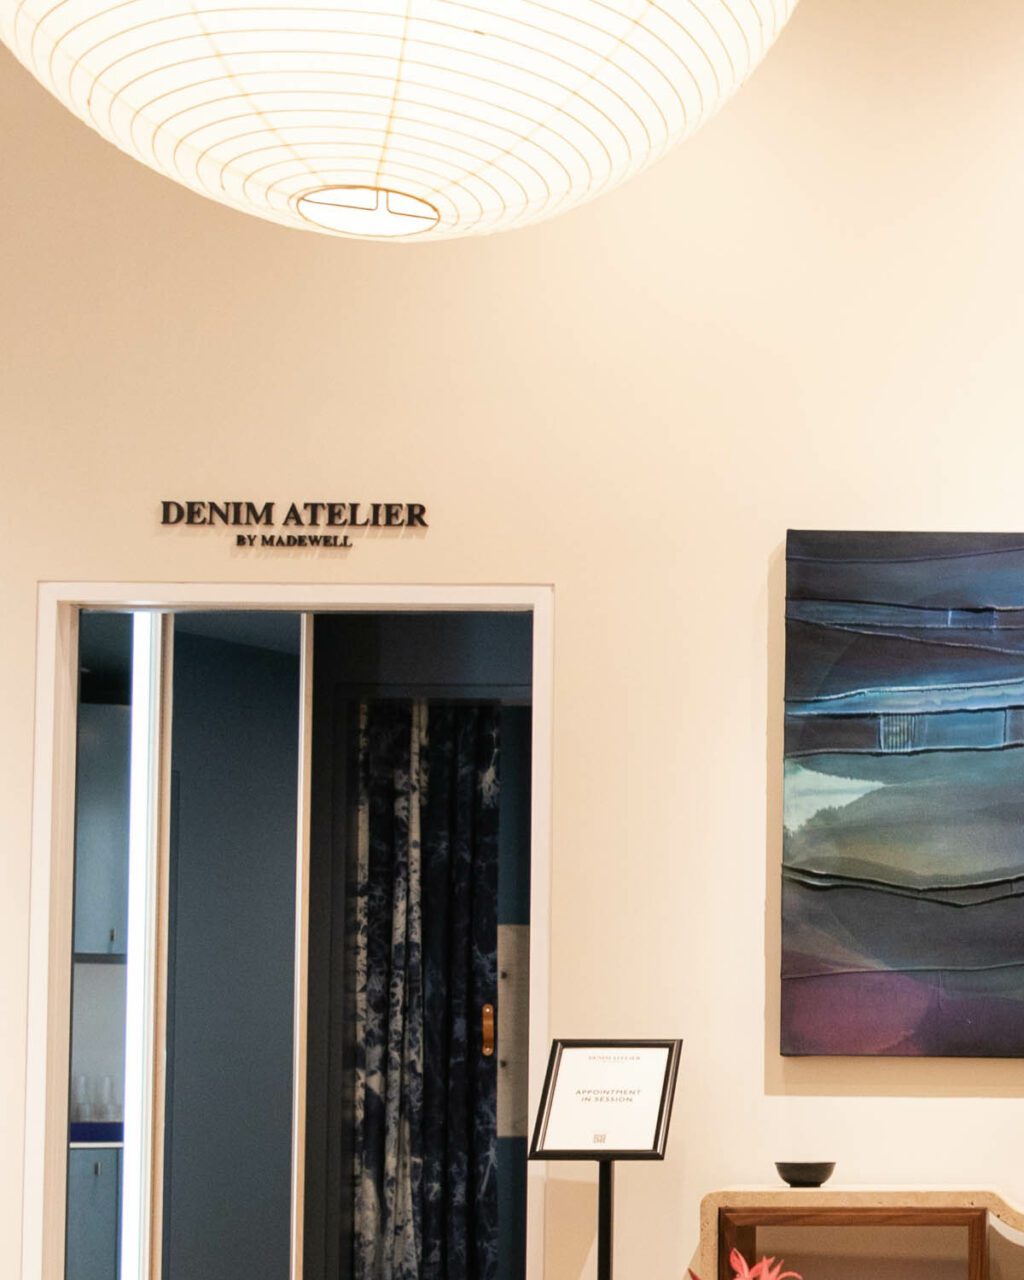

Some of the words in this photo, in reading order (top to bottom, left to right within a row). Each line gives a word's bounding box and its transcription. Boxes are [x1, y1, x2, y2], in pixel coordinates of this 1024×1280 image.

[160, 500, 275, 526] DENIM
[282, 502, 429, 528] ATELIER
[236, 534, 257, 547] BY
[261, 534, 353, 548] MADEWELL
